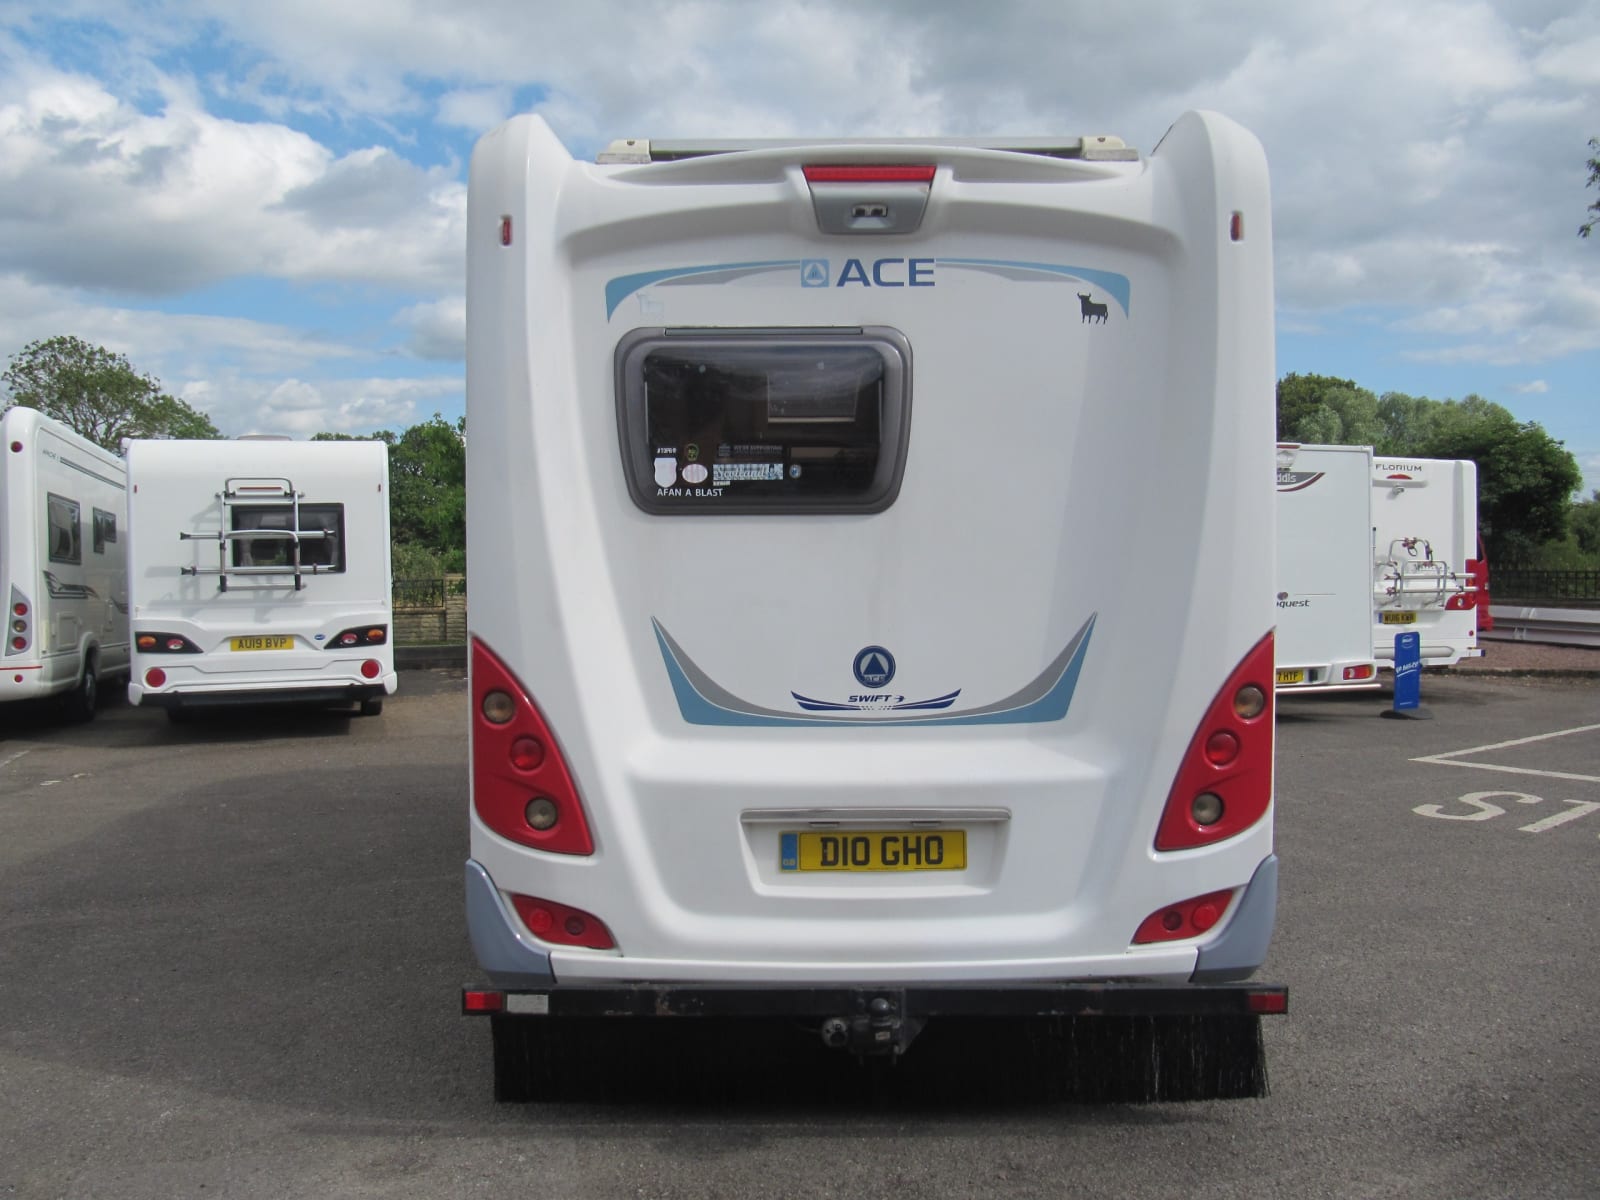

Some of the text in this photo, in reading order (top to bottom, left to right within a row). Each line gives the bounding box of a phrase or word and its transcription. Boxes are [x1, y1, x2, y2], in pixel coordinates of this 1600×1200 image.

[836, 258, 936, 287] ACE
[1375, 463, 1422, 472] FLORIUM
[657, 488, 723, 496] AFAN A BLAST
[238, 637, 287, 649] AU19 BVP
[848, 694, 892, 703] SWIFT
[881, 836, 944, 866] GHO
